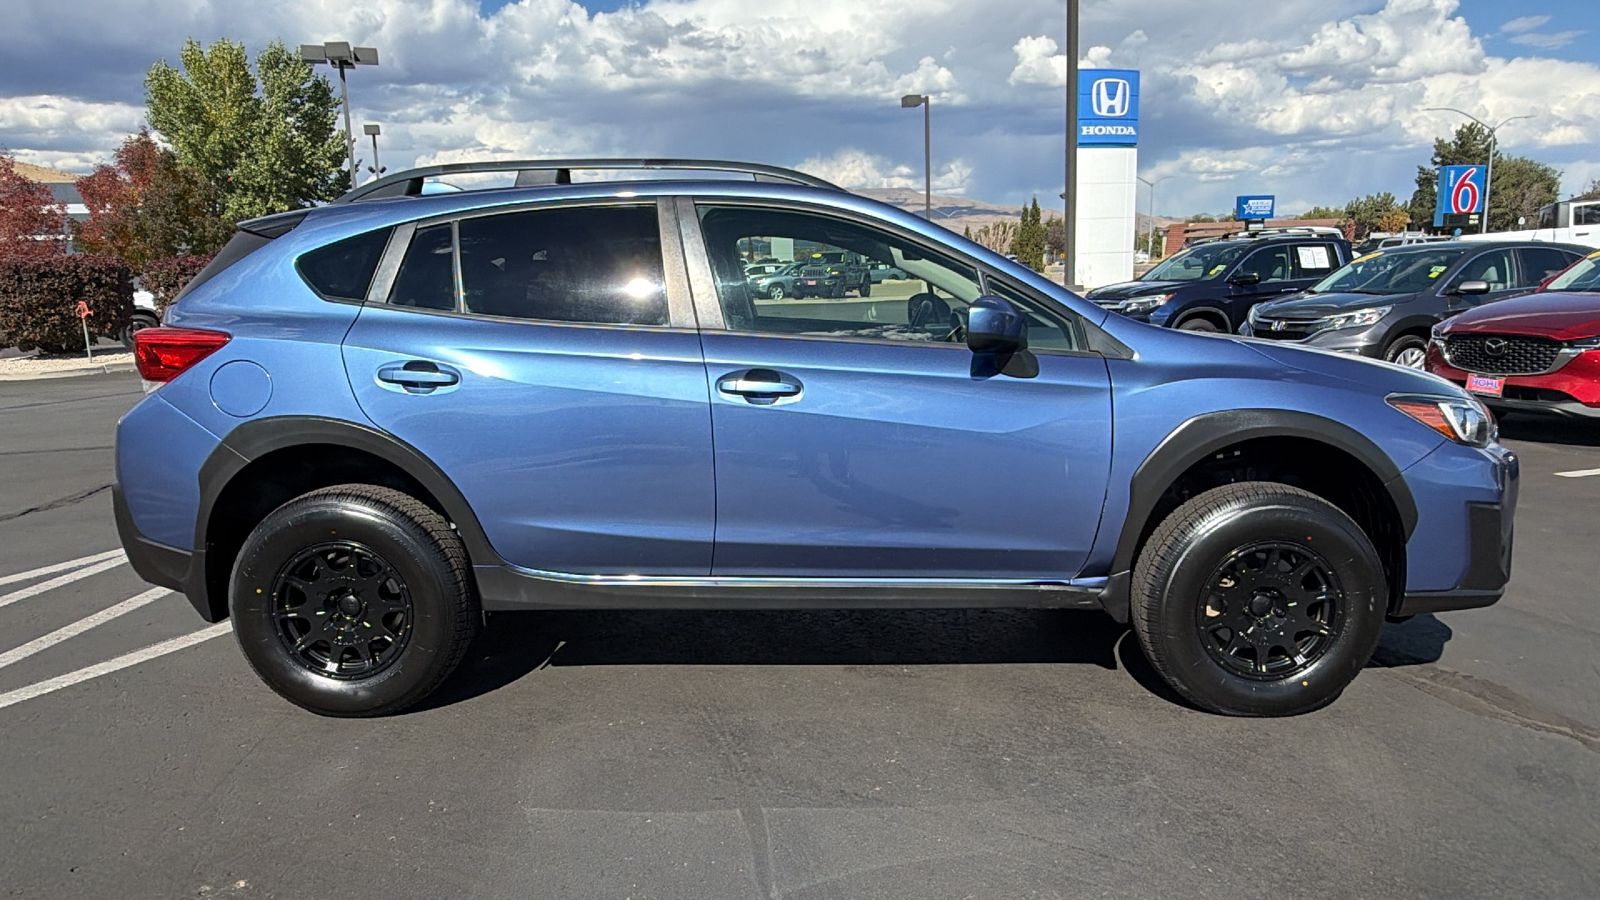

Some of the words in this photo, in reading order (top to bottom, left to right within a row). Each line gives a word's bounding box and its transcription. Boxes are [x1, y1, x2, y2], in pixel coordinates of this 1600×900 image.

[1081, 126, 1136, 135] HONDA
[1451, 167, 1479, 214] 6
[1470, 377, 1500, 389] HOHL
